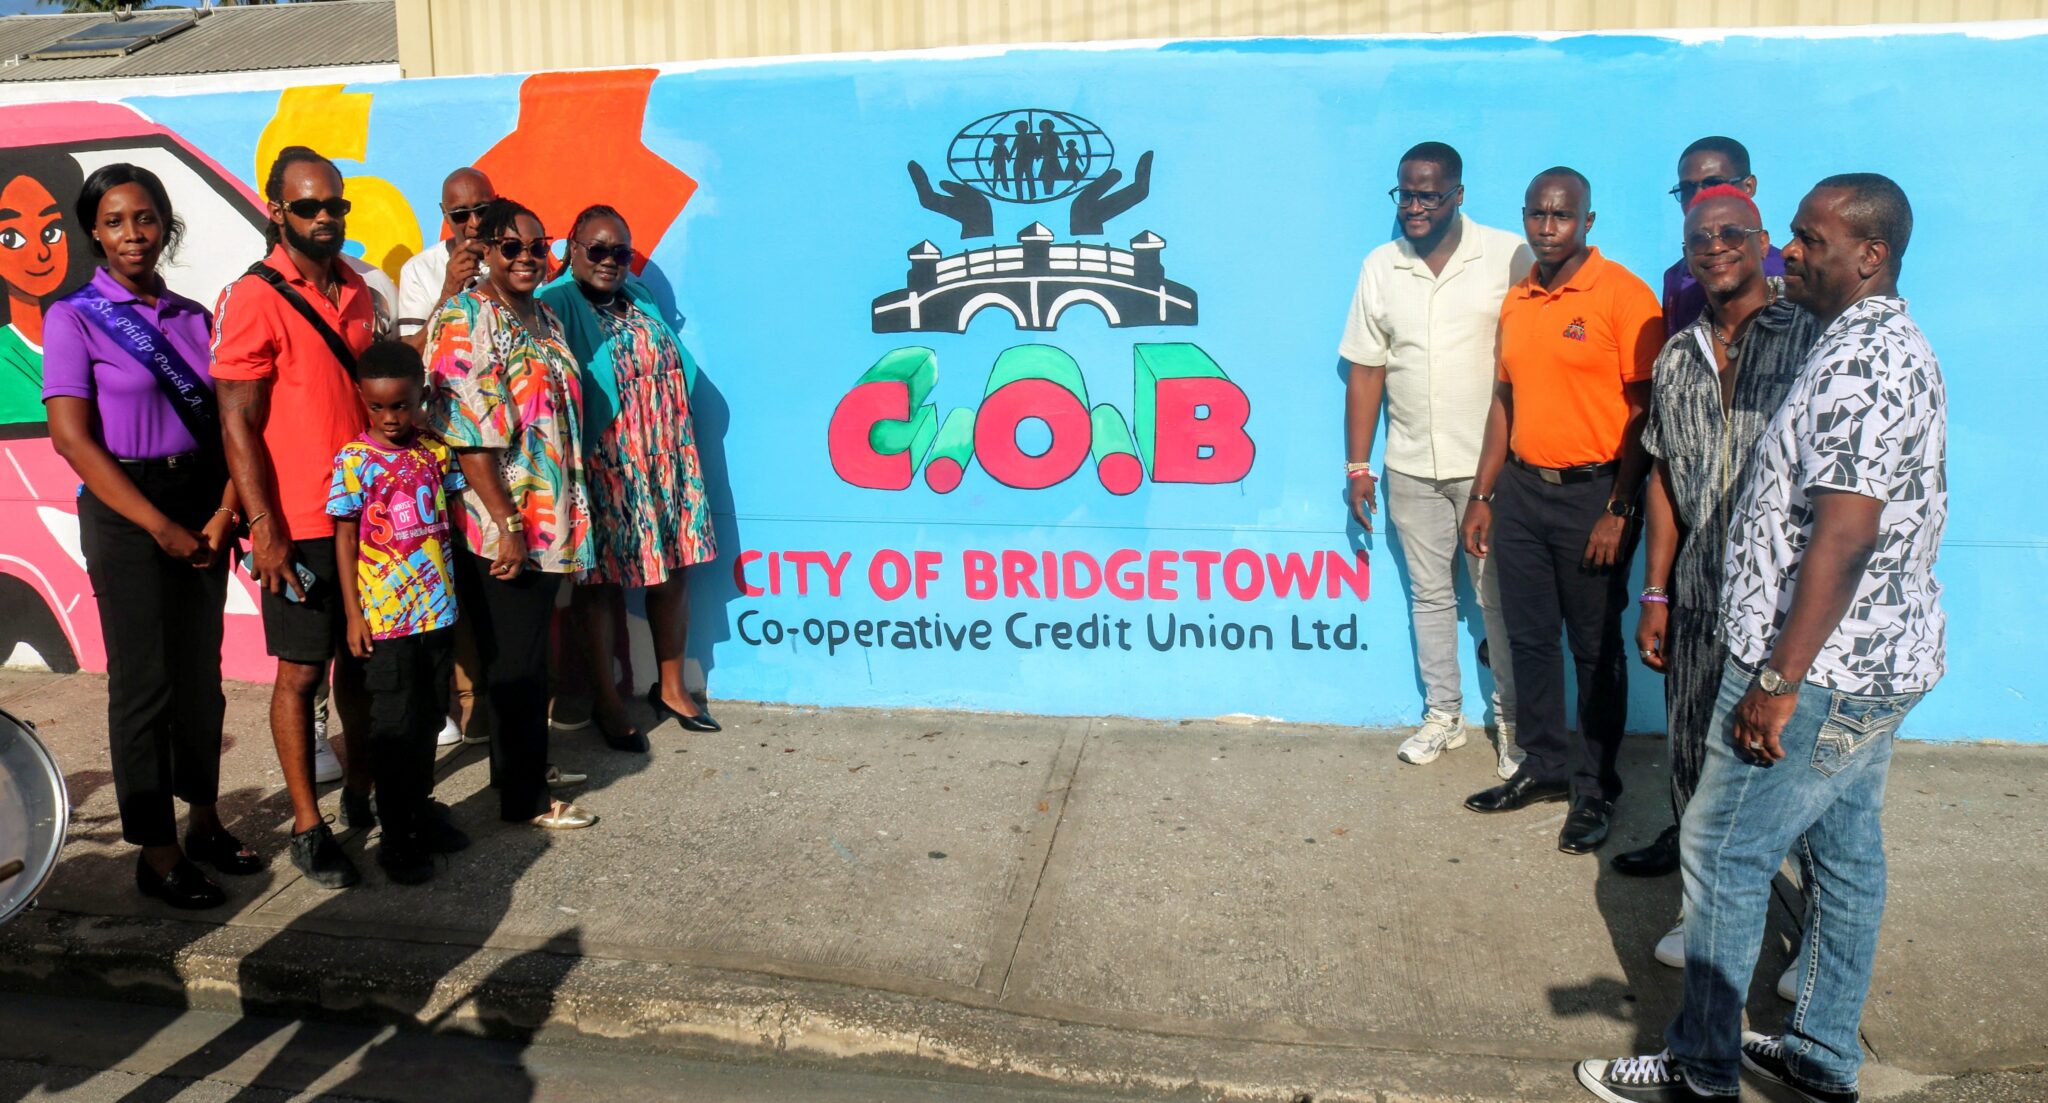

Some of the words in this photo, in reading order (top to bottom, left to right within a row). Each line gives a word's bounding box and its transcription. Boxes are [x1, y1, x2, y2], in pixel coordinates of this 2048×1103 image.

[91, 300, 113, 318] St.
[116, 316, 155, 352] Philip
[154, 352, 194, 395] Parish
[399, 510, 411, 524] OF
[733, 549, 852, 598] CITY
[868, 549, 943, 601] OF
[962, 548, 1370, 602] BRIDGETOWN
[737, 609, 992, 656] Co-operative
[1005, 611, 1132, 650] Credit
[1147, 612, 1274, 651] Union
[1292, 613, 1368, 651] Ltd.
